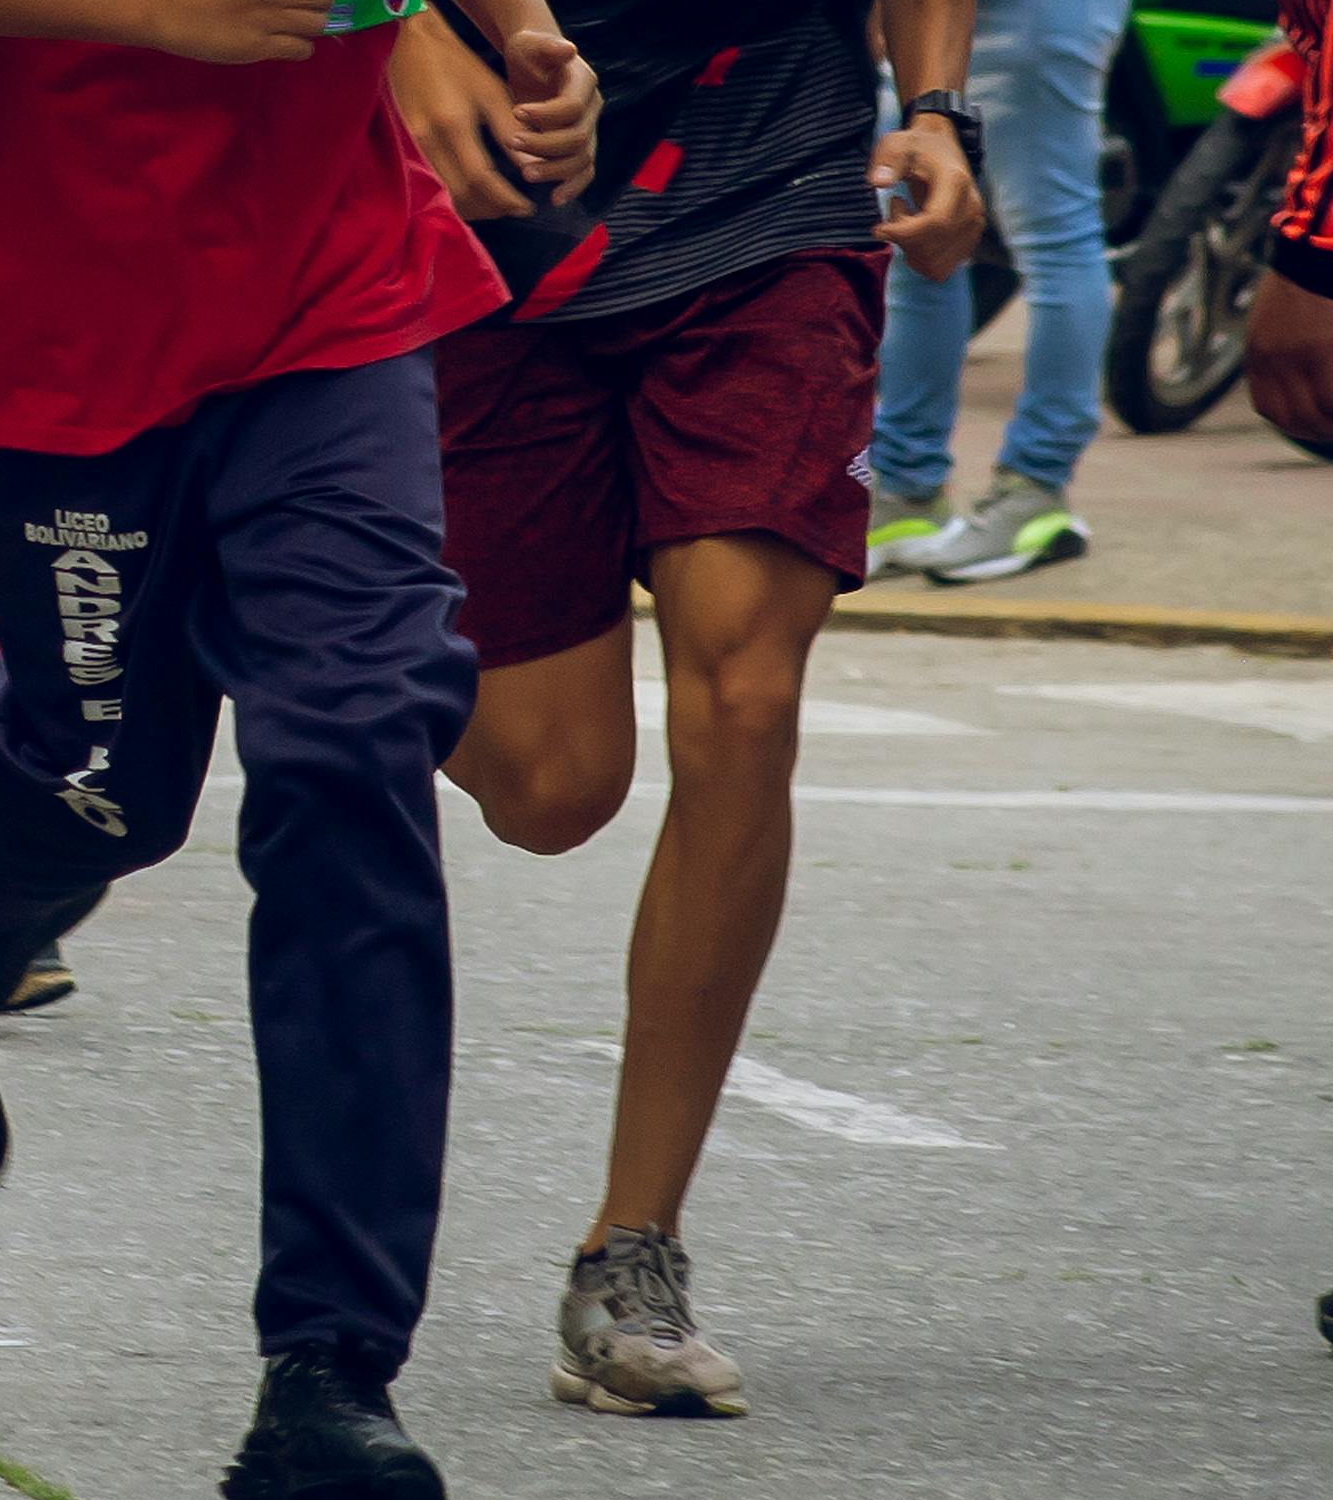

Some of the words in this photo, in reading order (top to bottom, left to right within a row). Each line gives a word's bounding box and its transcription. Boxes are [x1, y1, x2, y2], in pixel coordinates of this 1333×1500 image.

[54, 508, 110, 533] LICEO
[24, 522, 149, 551] BOLIVARIANO
[50, 549, 124, 687] ANDRES
